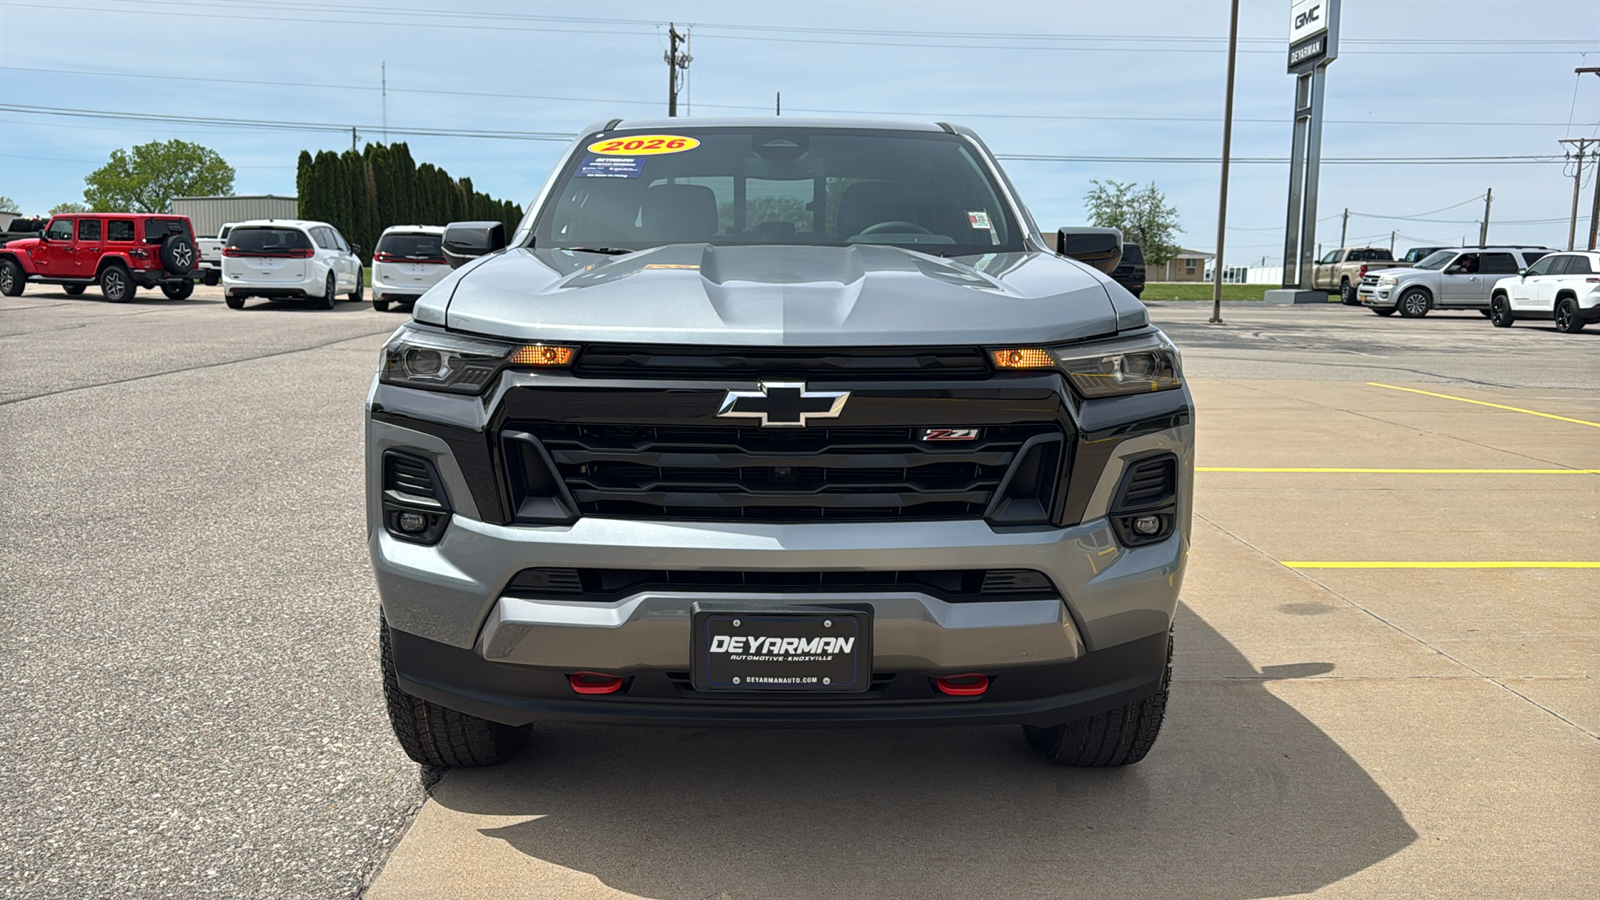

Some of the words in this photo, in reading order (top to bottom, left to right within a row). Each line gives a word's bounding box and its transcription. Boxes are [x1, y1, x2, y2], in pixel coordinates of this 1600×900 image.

[1295, 4, 1320, 30] GMC
[1291, 41, 1320, 64] DEYARMAN
[600, 138, 688, 152] 2026
[922, 428, 978, 441] Z71
[709, 635, 855, 654] DEYARMAN
[746, 676, 818, 684] DEYARMANAUTO.COM
